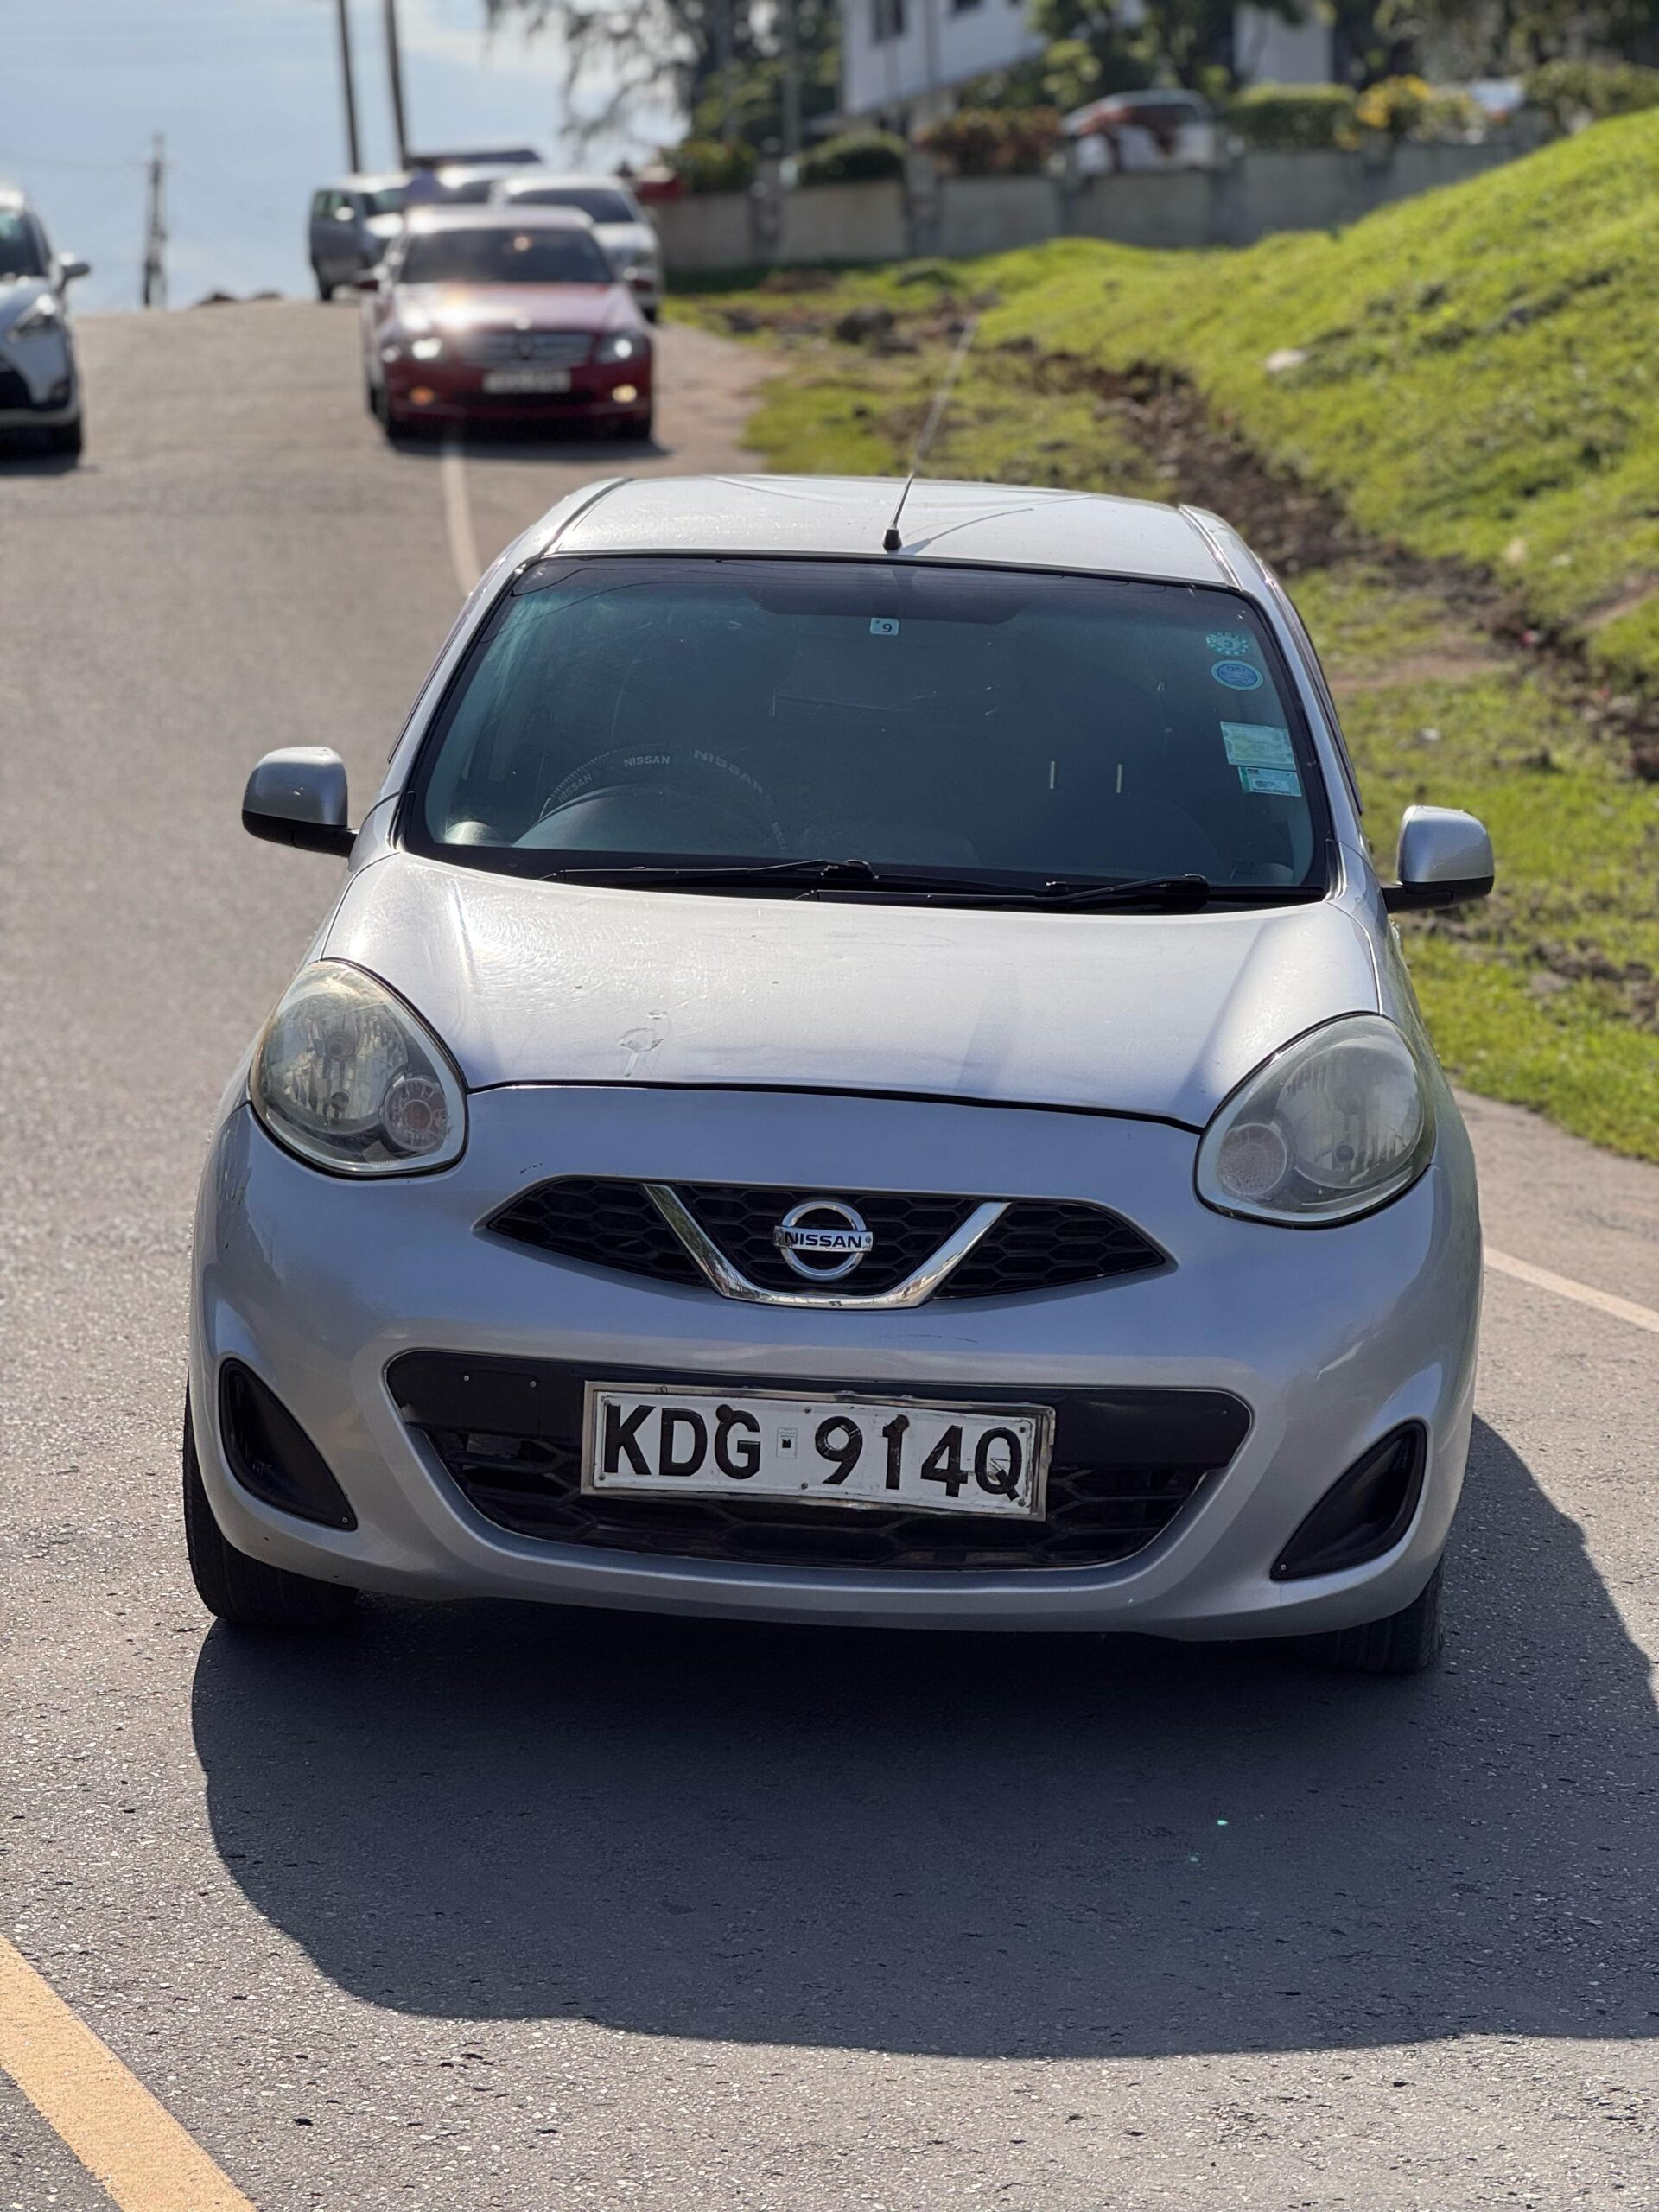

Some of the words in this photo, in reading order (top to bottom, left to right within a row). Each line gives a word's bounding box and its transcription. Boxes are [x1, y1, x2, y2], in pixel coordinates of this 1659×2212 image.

[883, 624, 892, 633] 9
[625, 756, 671, 767] NISSAN
[694, 749, 764, 794] NISSAN
[558, 774, 593, 803] NISSAN
[785, 1231, 862, 1249] NISSAN
[604, 1404, 761, 1480] KDG
[815, 1414, 1022, 1501] 914Q
